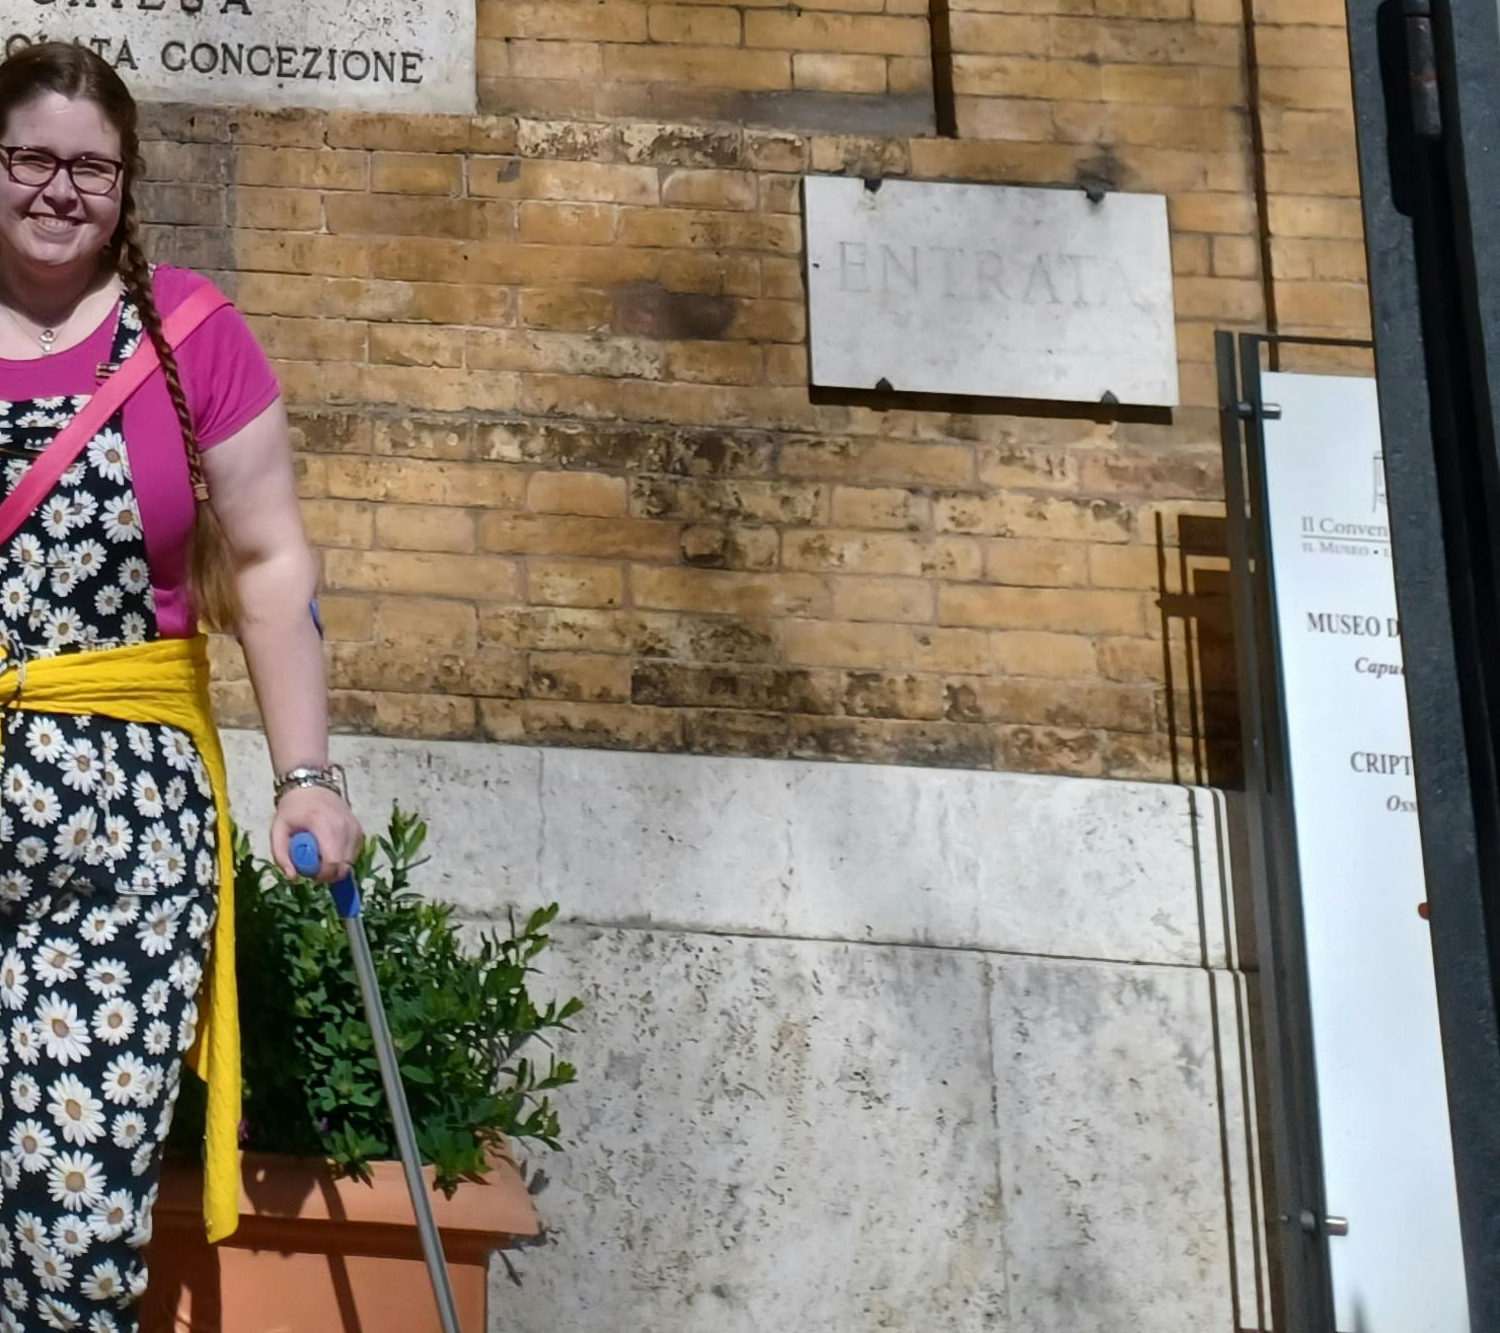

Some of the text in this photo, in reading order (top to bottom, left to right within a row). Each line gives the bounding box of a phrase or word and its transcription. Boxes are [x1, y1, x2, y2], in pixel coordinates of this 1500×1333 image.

[161, 40, 424, 84] CONCEZIONE
[839, 241, 1150, 309] ENTRATA
[1307, 612, 1381, 637] MUSEO
